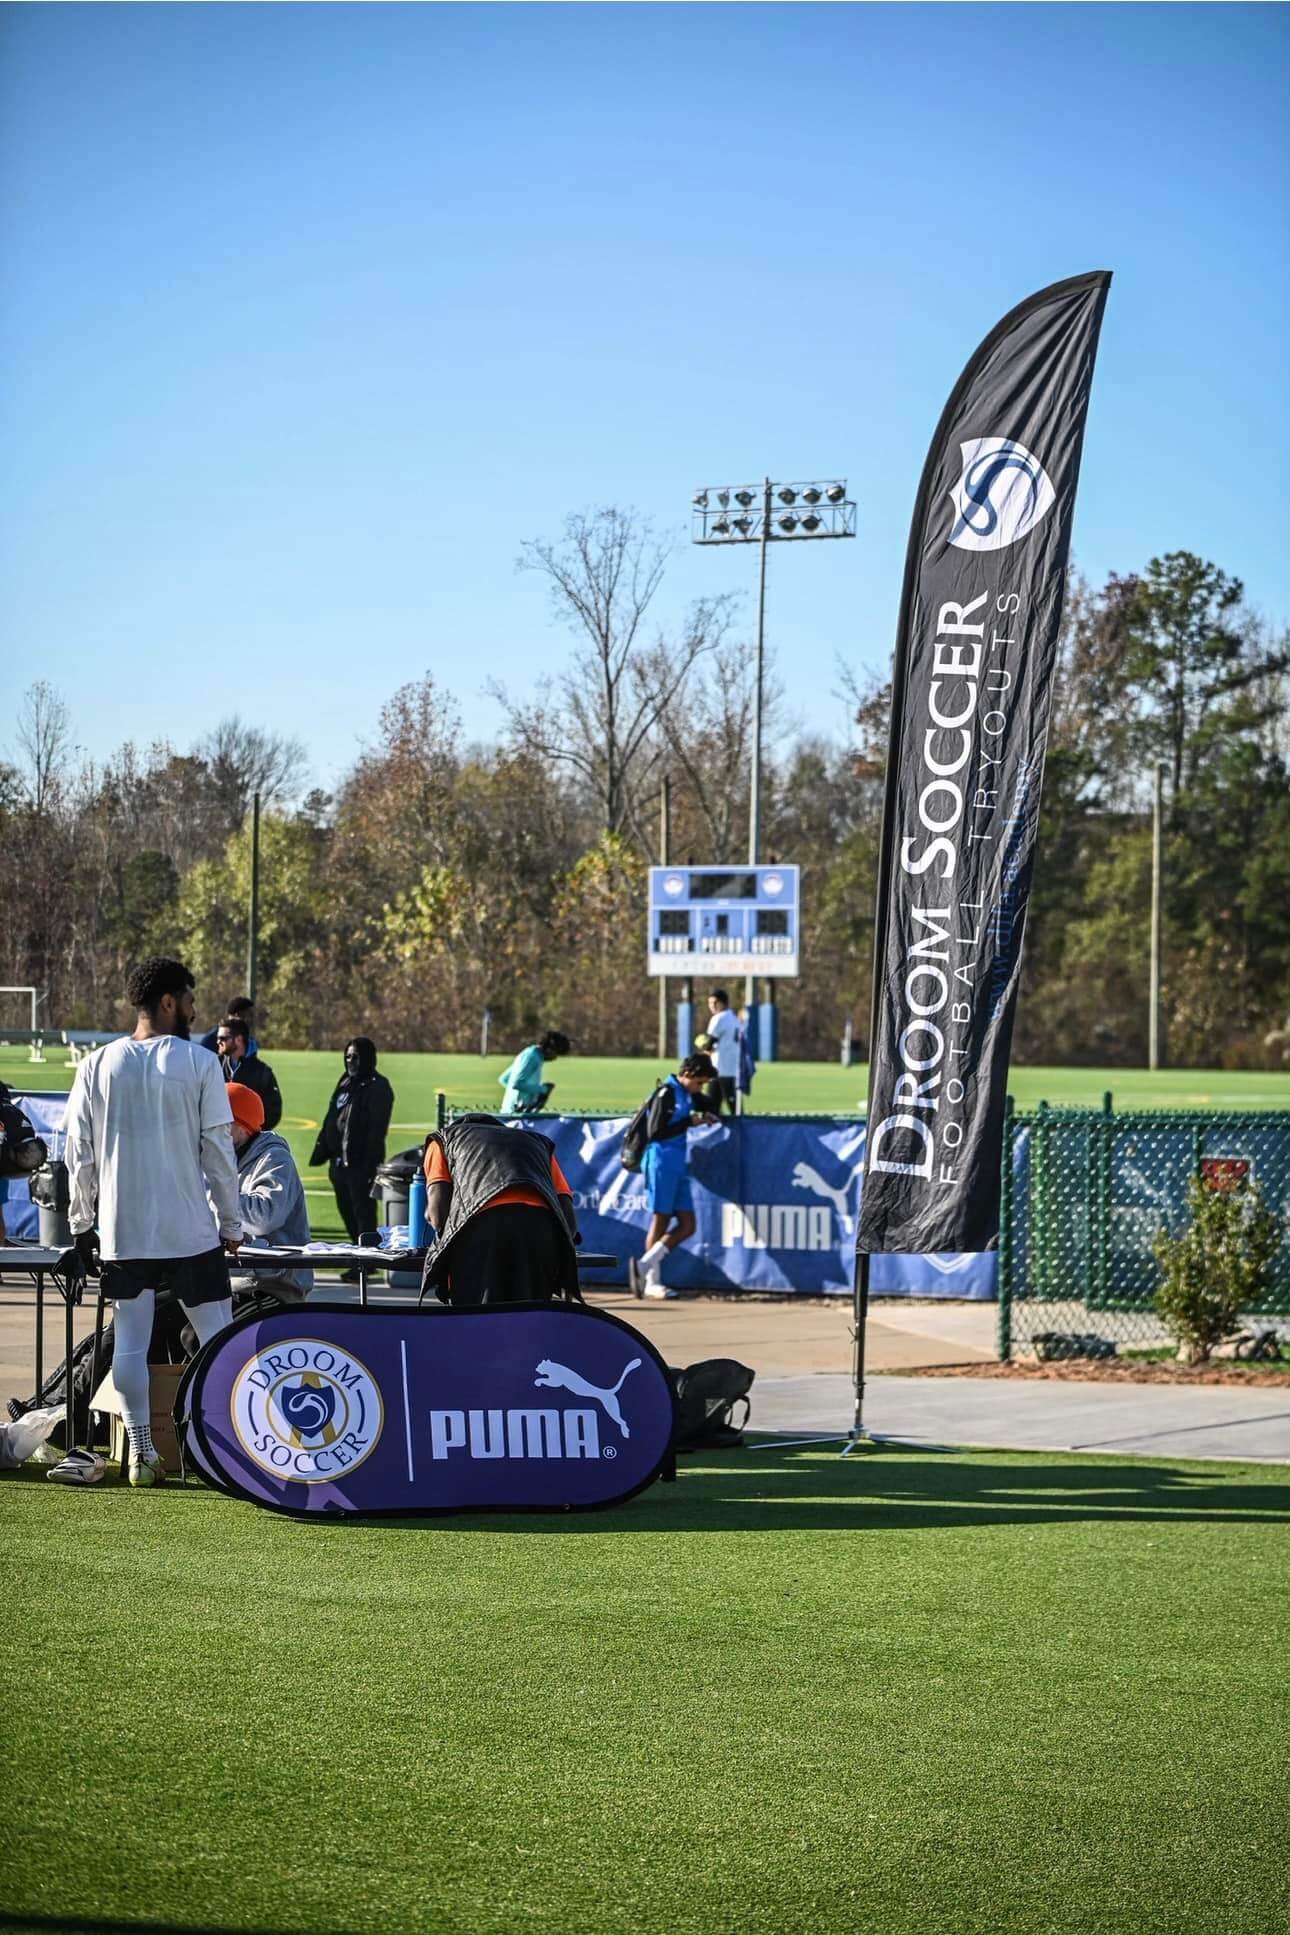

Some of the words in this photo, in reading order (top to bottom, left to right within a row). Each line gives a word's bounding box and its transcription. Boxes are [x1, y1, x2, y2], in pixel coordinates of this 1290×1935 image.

[901, 590, 988, 879] SOCCER
[939, 889, 985, 1185] FOOTBALL
[968, 592, 1020, 847] TRYOUTS
[869, 904, 952, 1182] DROOM
[722, 1203, 831, 1251] PUMA
[247, 1348, 364, 1392] DROOM
[254, 1432, 369, 1474] SOCCER
